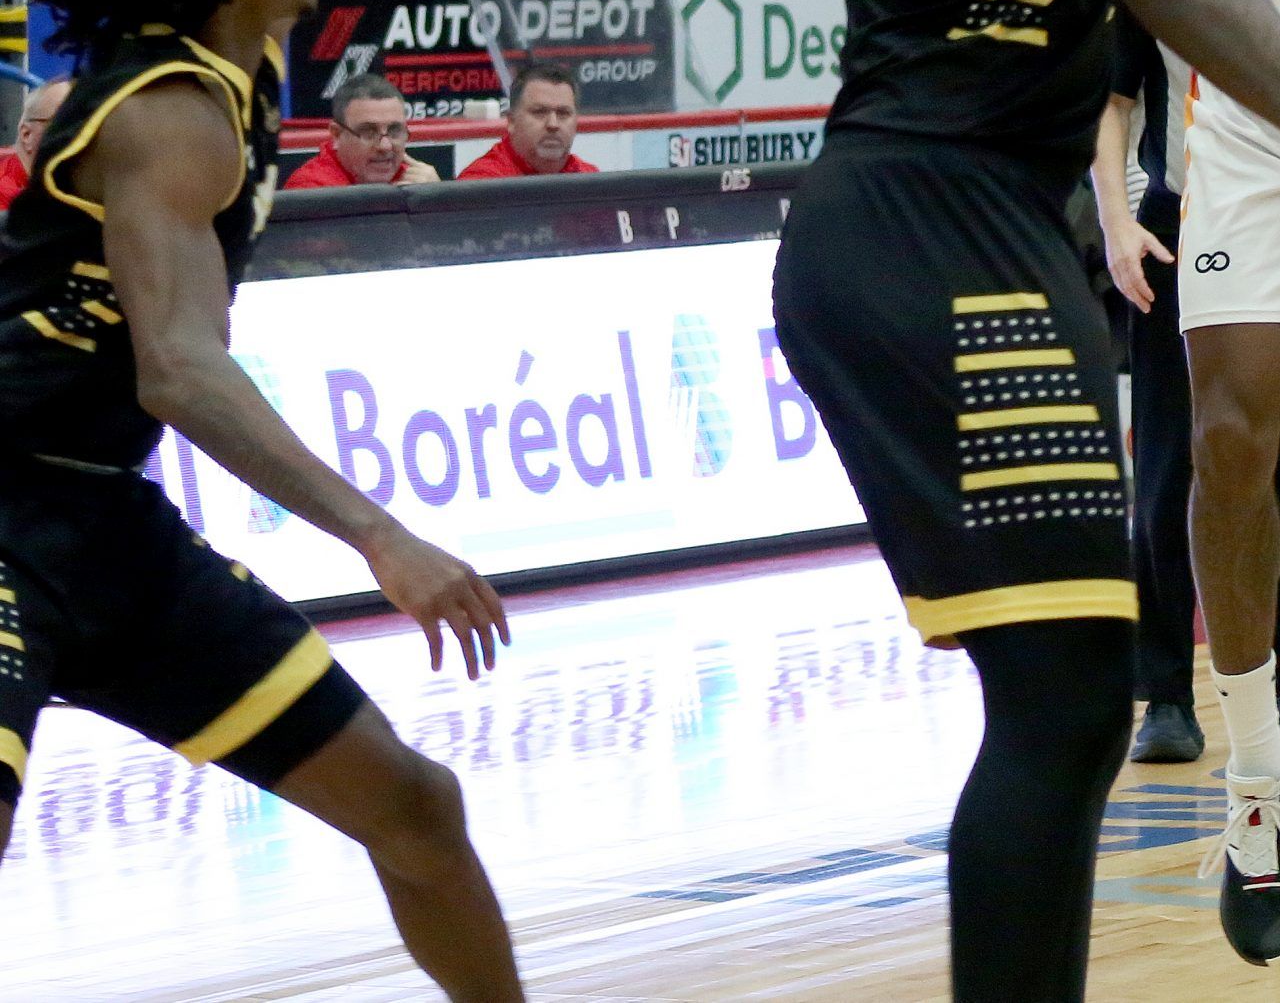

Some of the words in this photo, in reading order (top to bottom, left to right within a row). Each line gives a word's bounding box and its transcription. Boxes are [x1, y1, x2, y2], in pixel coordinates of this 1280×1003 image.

[384, 2, 501, 50] AUTO
[577, 59, 657, 83] GROUP
[694, 131, 816, 166] SUDBURY
[616, 210, 634, 244] B
[665, 206, 680, 240] P
[324, 329, 653, 510] Boréal
